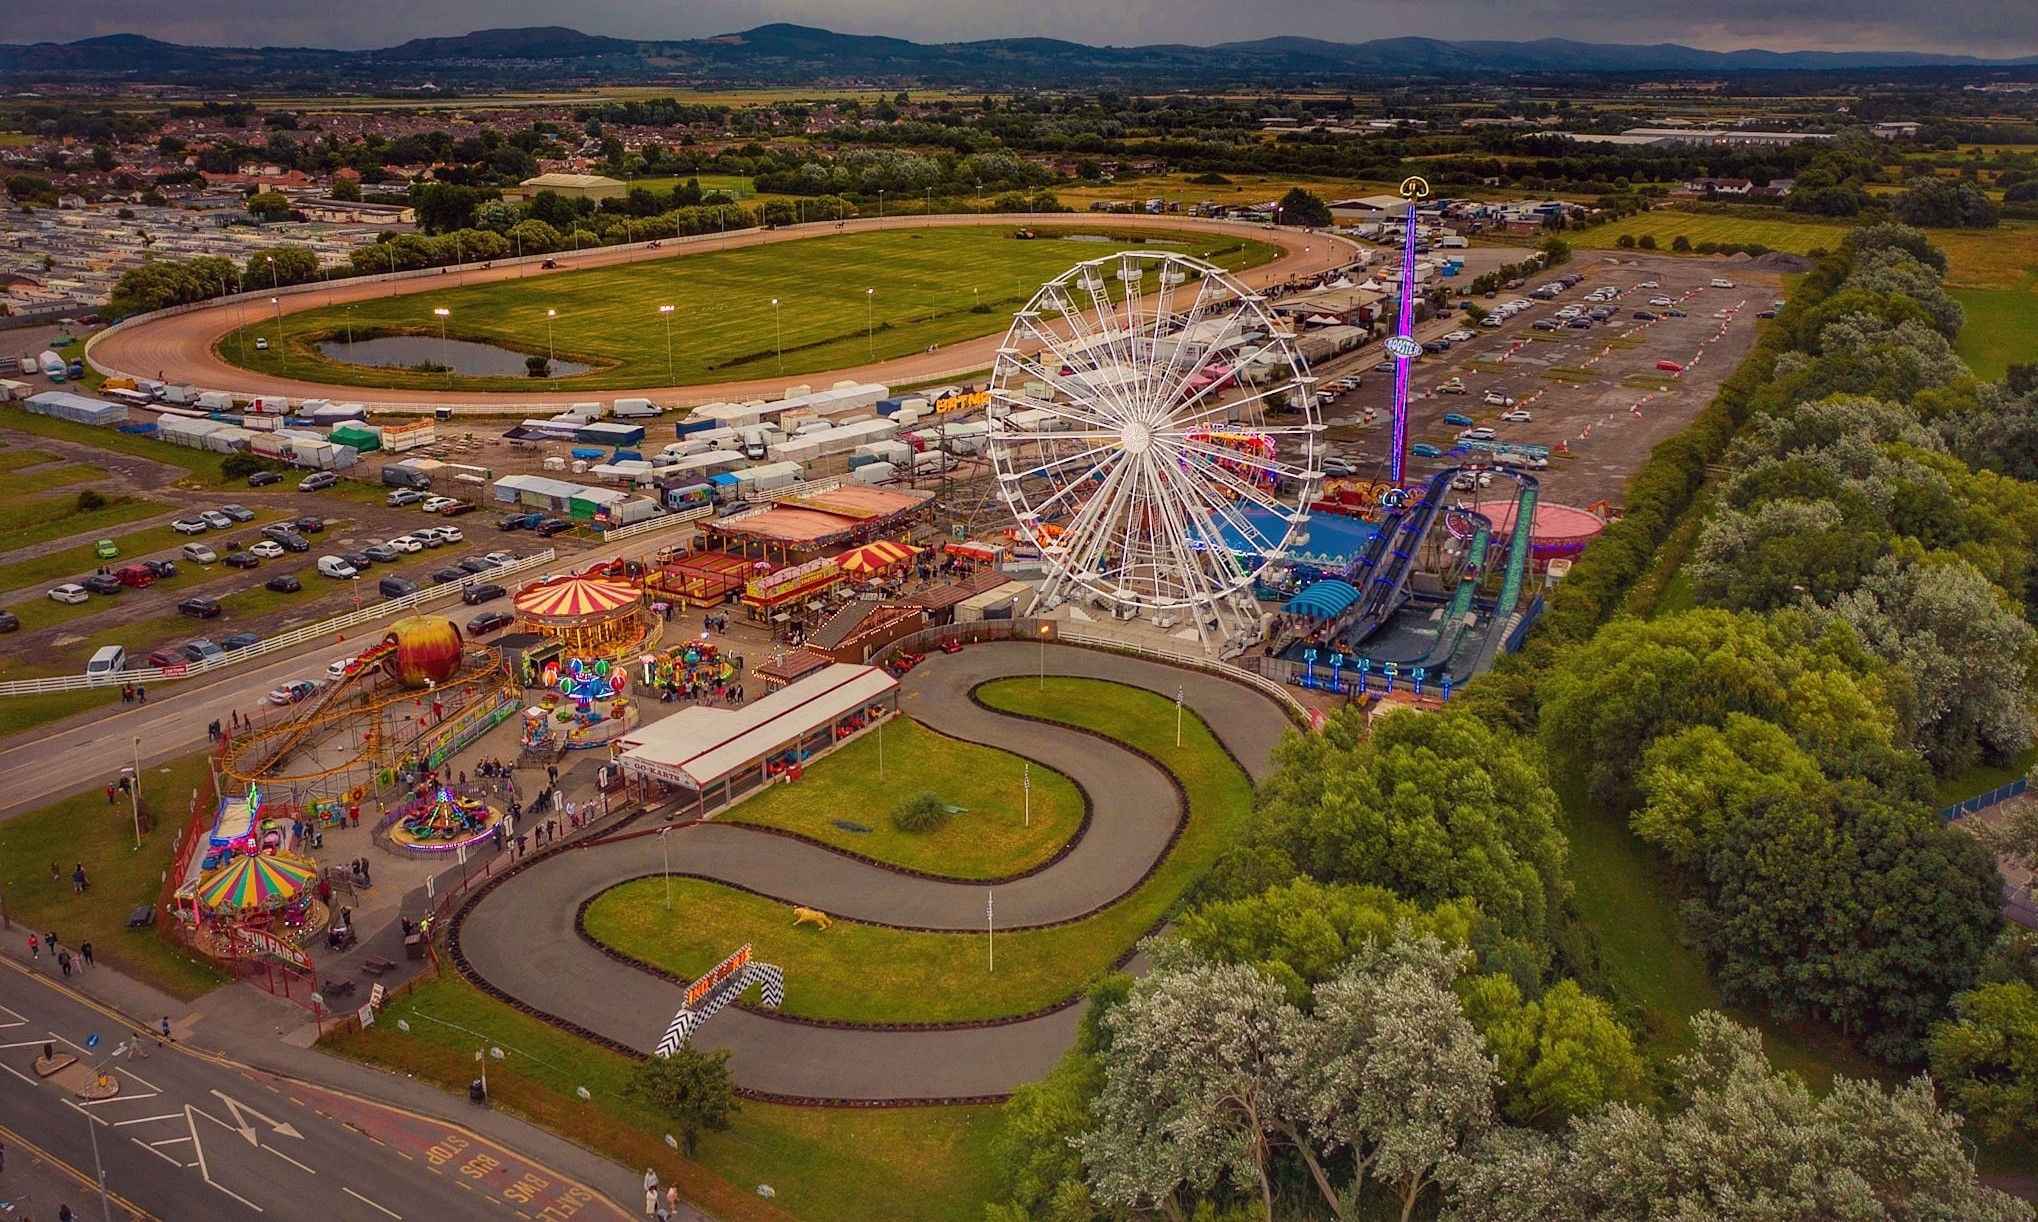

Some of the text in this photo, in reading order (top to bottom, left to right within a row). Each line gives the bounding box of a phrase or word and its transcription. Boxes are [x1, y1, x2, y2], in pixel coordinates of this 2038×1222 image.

[1387, 339, 1420, 355] BOOSTER
[634, 763, 681, 782] GO-KARTS
[243, 930, 295, 963] FUN FAIR
[426, 1135, 470, 1166] STOP
[459, 1153, 501, 1179] BUS
[503, 1172, 550, 1204] BWS
